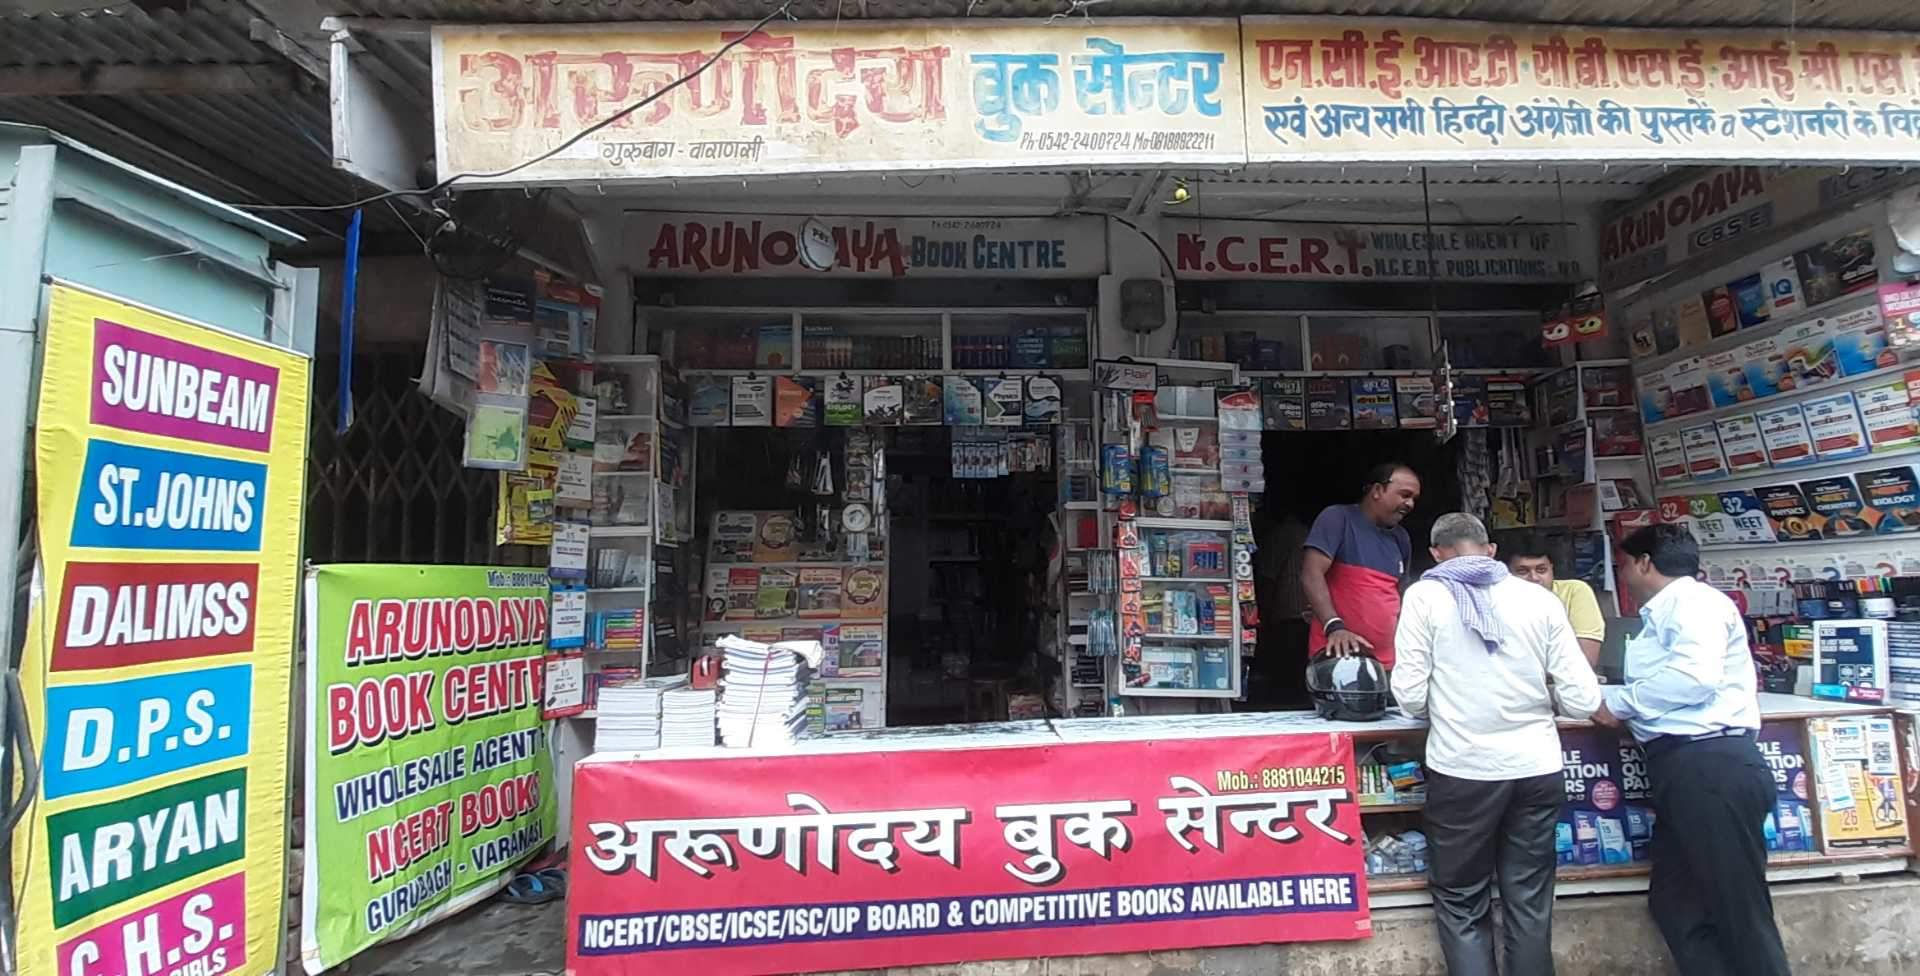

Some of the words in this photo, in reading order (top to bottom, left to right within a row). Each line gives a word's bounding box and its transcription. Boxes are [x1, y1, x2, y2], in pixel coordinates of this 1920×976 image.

[969, 53, 1059, 142] बुक
[1072, 37, 1225, 116] सेन्टर
[1312, 103, 1370, 138] अन्य
[1432, 94, 1505, 146] हिन्दी
[1599, 99, 1631, 136] की
[648, 219, 906, 278] ARUNOAYA
[1599, 166, 1764, 260] ARUNODAYA
[1176, 231, 1374, 277] N.C.E.R.T.
[101, 343, 271, 434] SUNBEAM
[93, 462, 256, 534] ST.JOHNS
[1661, 502, 1679, 518] 32
[1689, 499, 1707, 514] 32
[1722, 496, 1746, 514] 32
[1733, 516, 1763, 529] NEET
[1872, 494, 1917, 506] BIOLOGY
[64, 581, 249, 648] DALIMSS
[344, 597, 548, 667] ARUNODAYA
[62, 688, 232, 772] D.P.S.
[327, 670, 436, 756] BOOK
[334, 746, 465, 824] WHOLESALE
[1217, 769, 1258, 791] Mob.:
[1262, 766, 1345, 789] 8881044215
[58, 788, 241, 903] ARYAN
[366, 800, 454, 885] NCERT
[995, 800, 1137, 886] बुक
[1158, 776, 1358, 852] सेन्टर
[366, 858, 452, 935] GURUBAGH
[471, 819, 544, 872] VARANASI
[584, 907, 861, 949] NCERT/CBSE/ICSE/ISC/UP
[867, 903, 940, 933] BOARD
[947, 902, 964, 926] &
[970, 892, 1111, 926] COMPETITIVE
[1117, 887, 1186, 915] BOOKS
[1190, 880, 1295, 912] AVAILABLE
[1299, 877, 1352, 906] HERE
[69, 892, 234, 976] CH.S.
